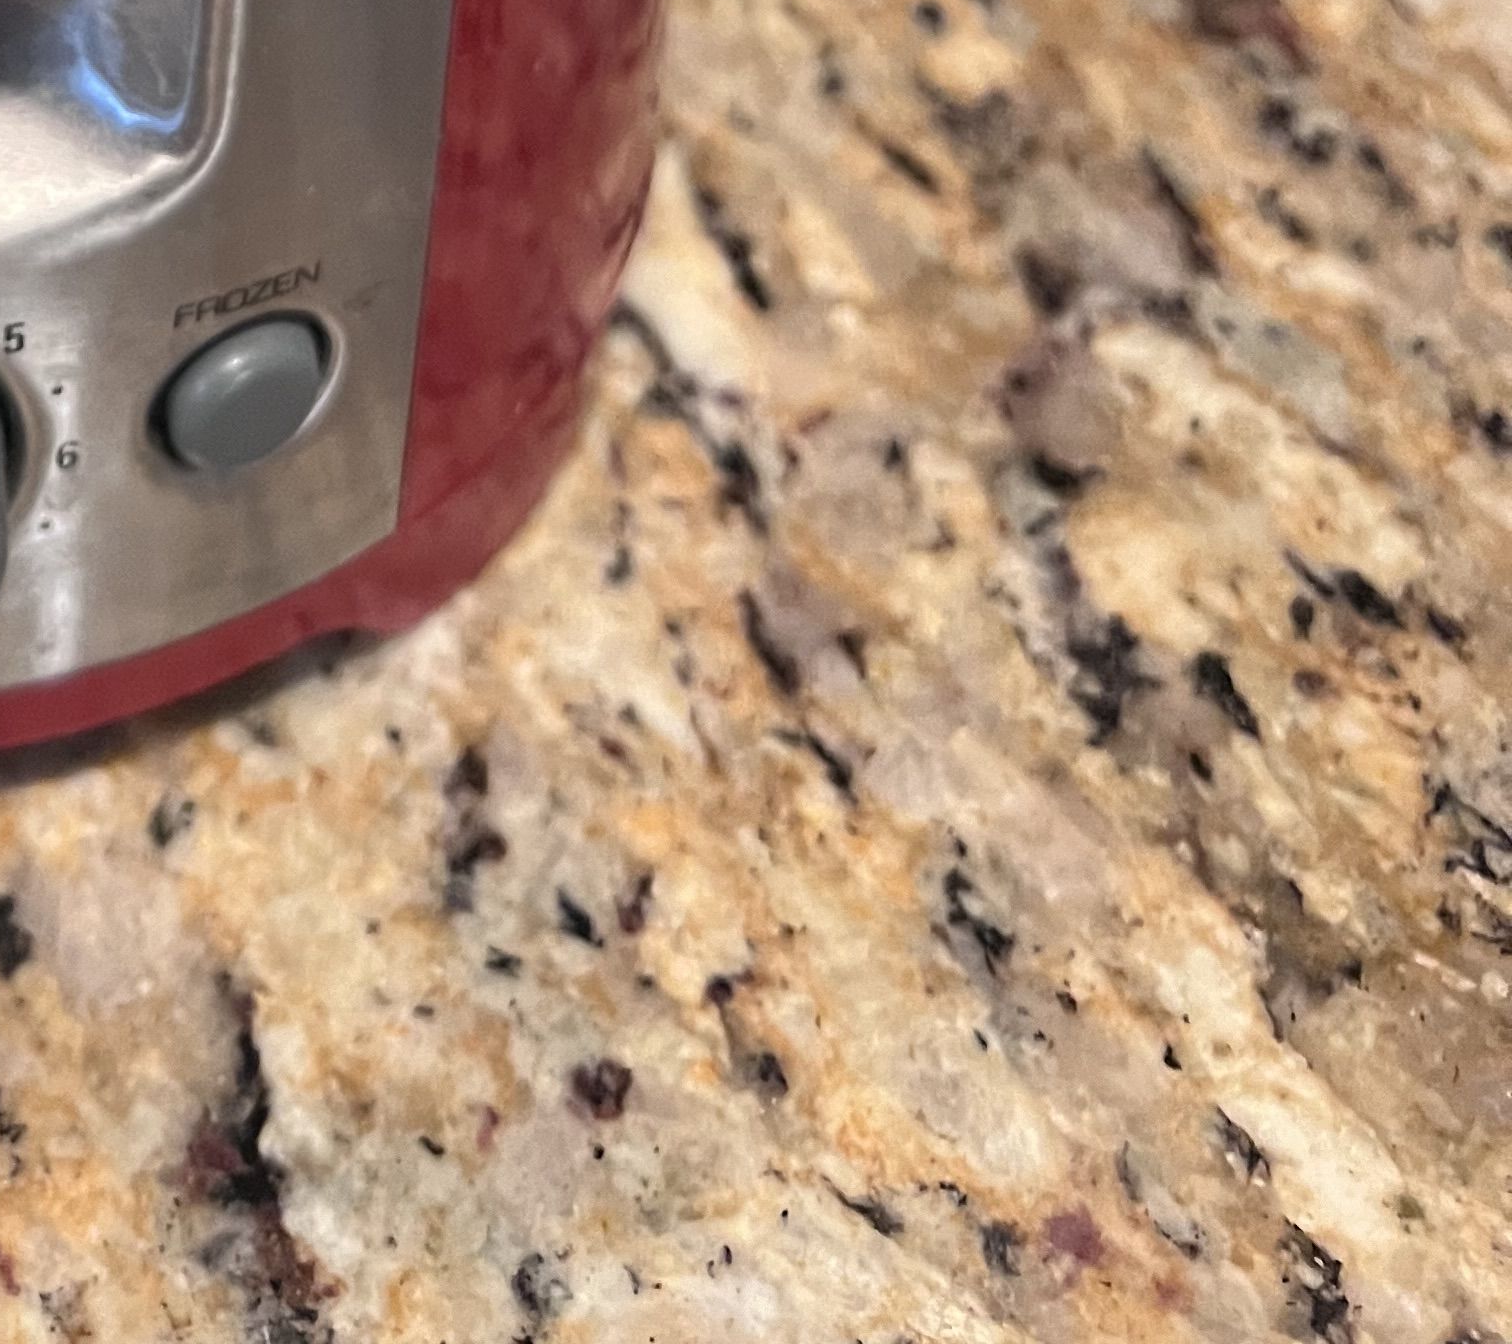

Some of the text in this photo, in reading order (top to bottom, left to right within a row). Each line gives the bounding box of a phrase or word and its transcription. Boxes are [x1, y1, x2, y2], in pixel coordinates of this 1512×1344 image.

[173, 260, 322, 328] FROZEN
[3, 322, 25, 354] 5
[55, 440, 79, 470] 6
